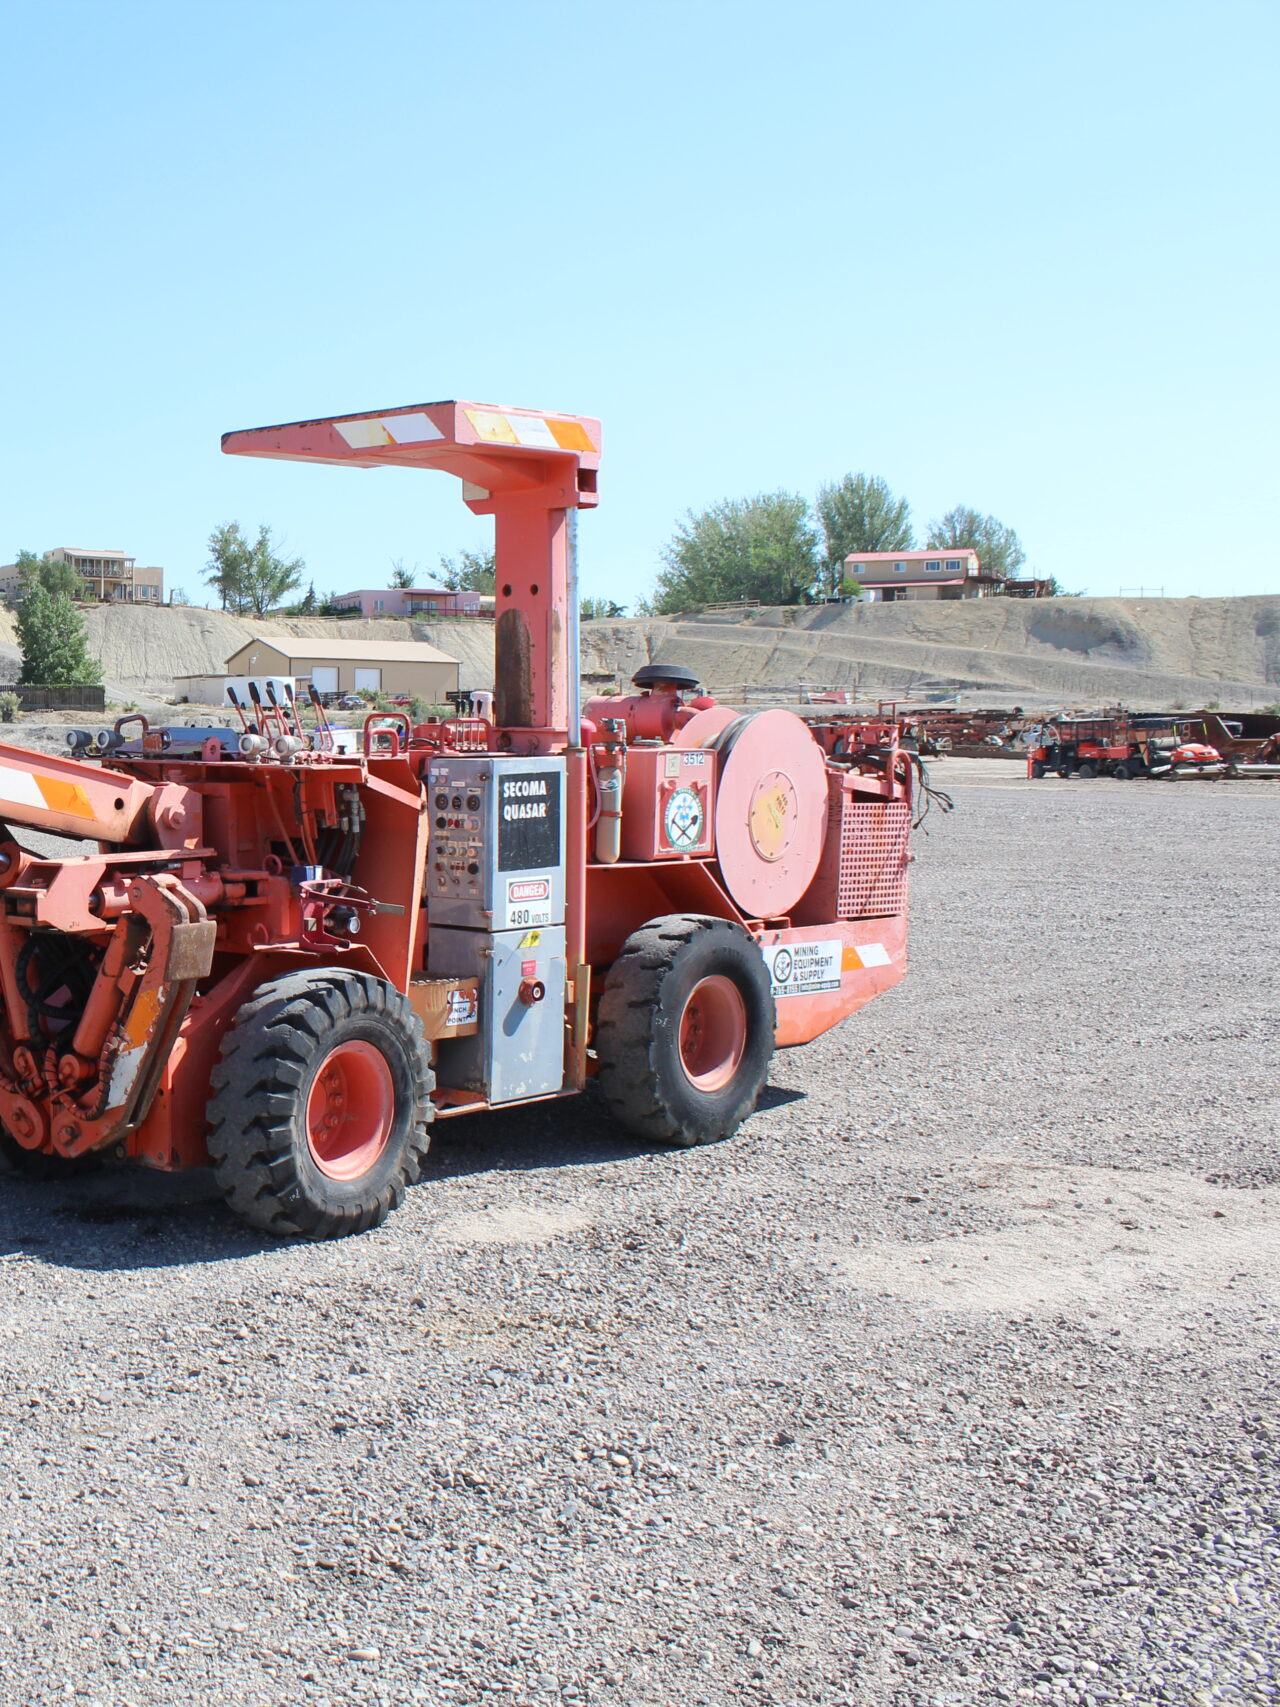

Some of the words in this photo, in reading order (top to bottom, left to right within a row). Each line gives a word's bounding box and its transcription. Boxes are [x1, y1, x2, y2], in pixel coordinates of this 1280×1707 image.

[684, 753, 704, 765] 3512
[503, 780, 547, 798] SECOMA
[503, 802, 547, 821] QUASAR
[513, 884, 545, 898] DANGER
[510, 909, 529, 925] 480
[531, 913, 549, 924] VOLTS
[794, 945, 819, 957] MINING
[793, 956, 833, 970] EQUIPMENT
[793, 972, 798, 982] &
[800, 969, 825, 981] SUPPLY
